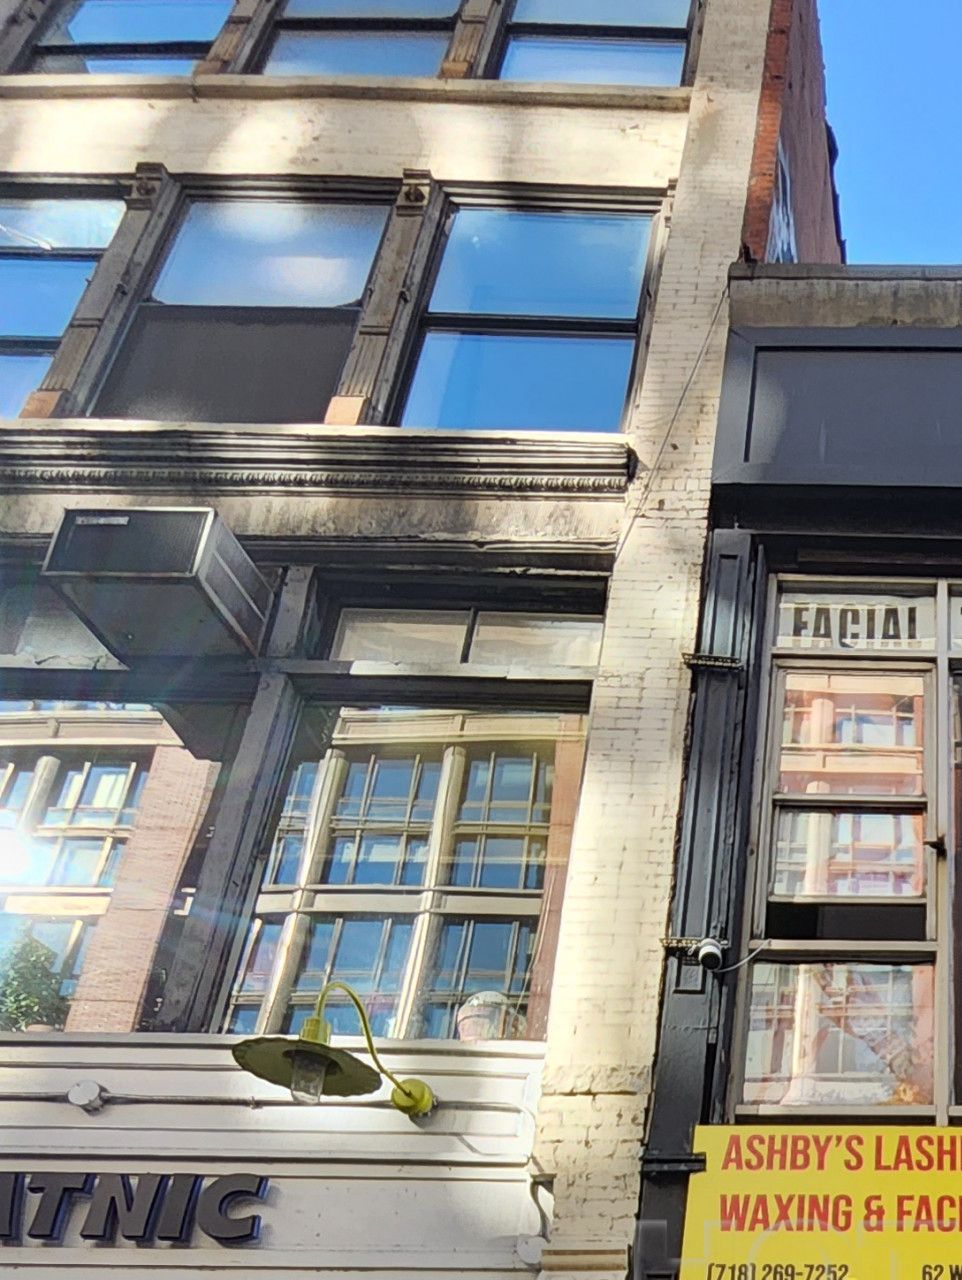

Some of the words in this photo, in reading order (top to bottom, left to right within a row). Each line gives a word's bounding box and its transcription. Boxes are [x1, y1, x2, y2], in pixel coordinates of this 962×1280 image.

[793, 603, 917, 648] FACIAL
[721, 1134, 864, 1171] ASHBY'S
[719, 1193, 853, 1232] WAXING
[862, 1194, 886, 1232] &
